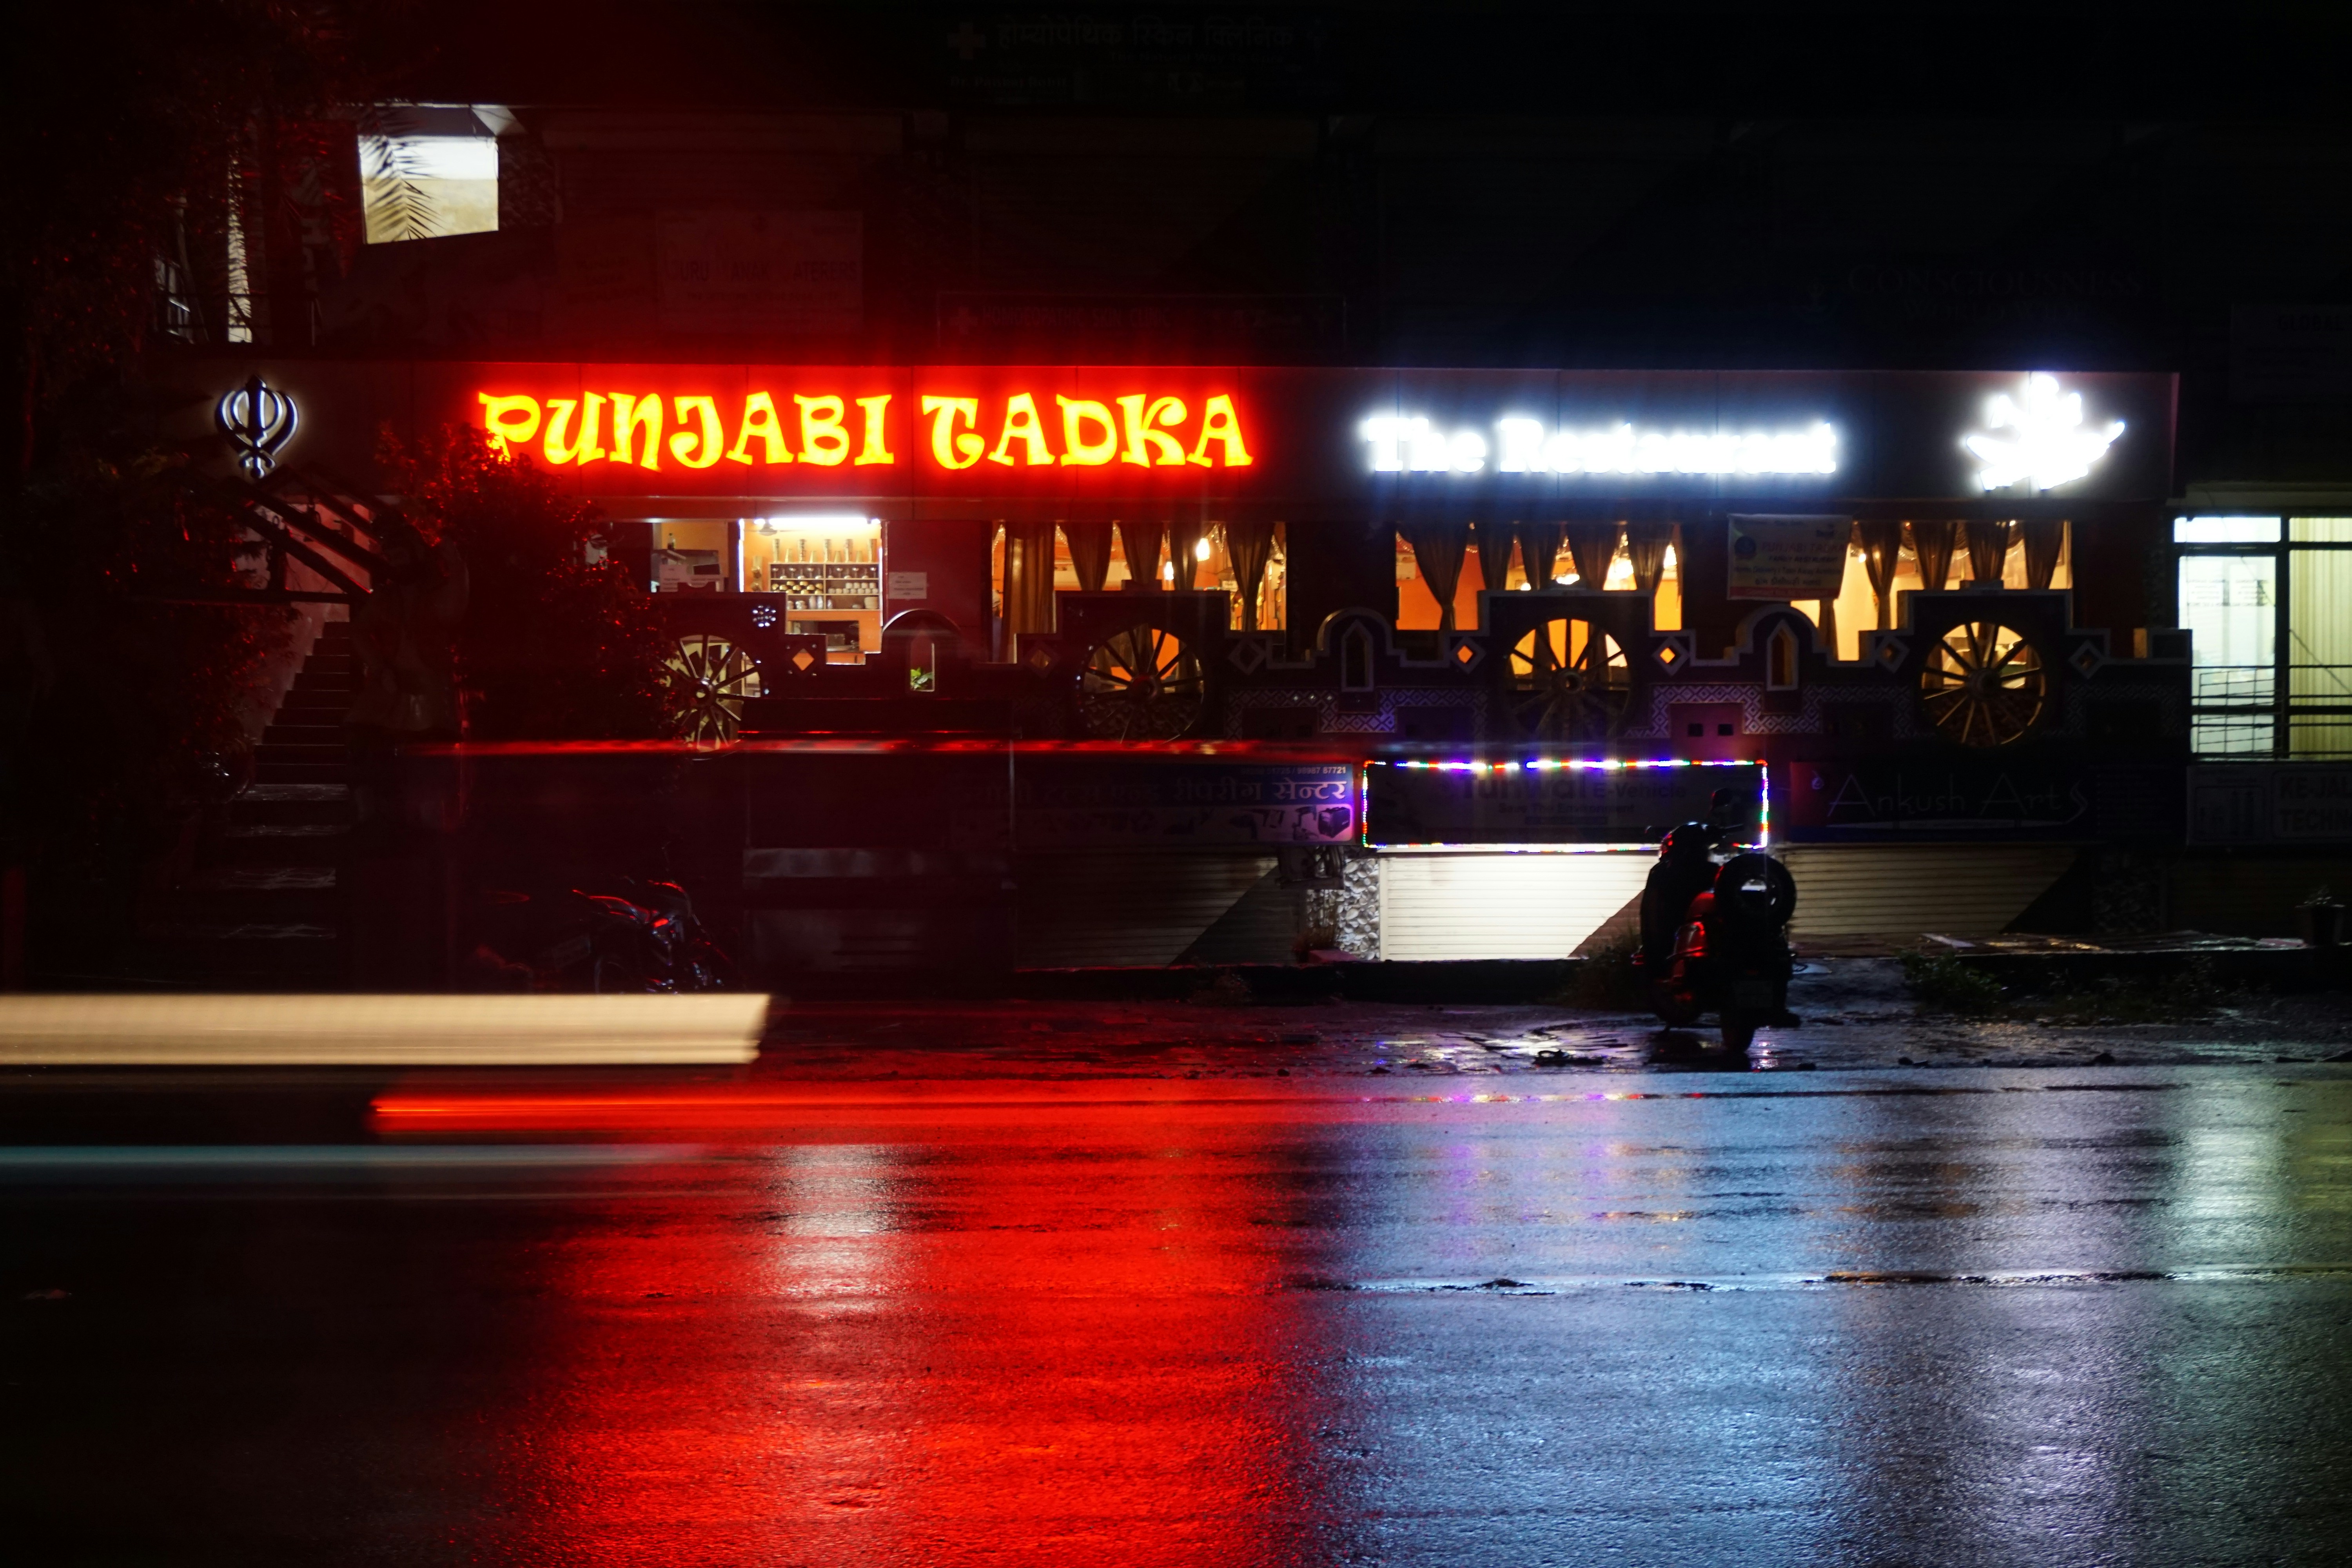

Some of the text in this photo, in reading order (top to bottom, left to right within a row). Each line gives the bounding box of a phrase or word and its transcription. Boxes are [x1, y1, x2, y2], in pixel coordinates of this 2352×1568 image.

[478, 391, 1254, 472] PUNJABI TADKA
[1367, 417, 1836, 474] The Restaurant
[1272, 777, 1347, 800] सेन्टर
[1827, 772, 1966, 817] Ankush
[2279, 808, 2352, 831] TECHN
